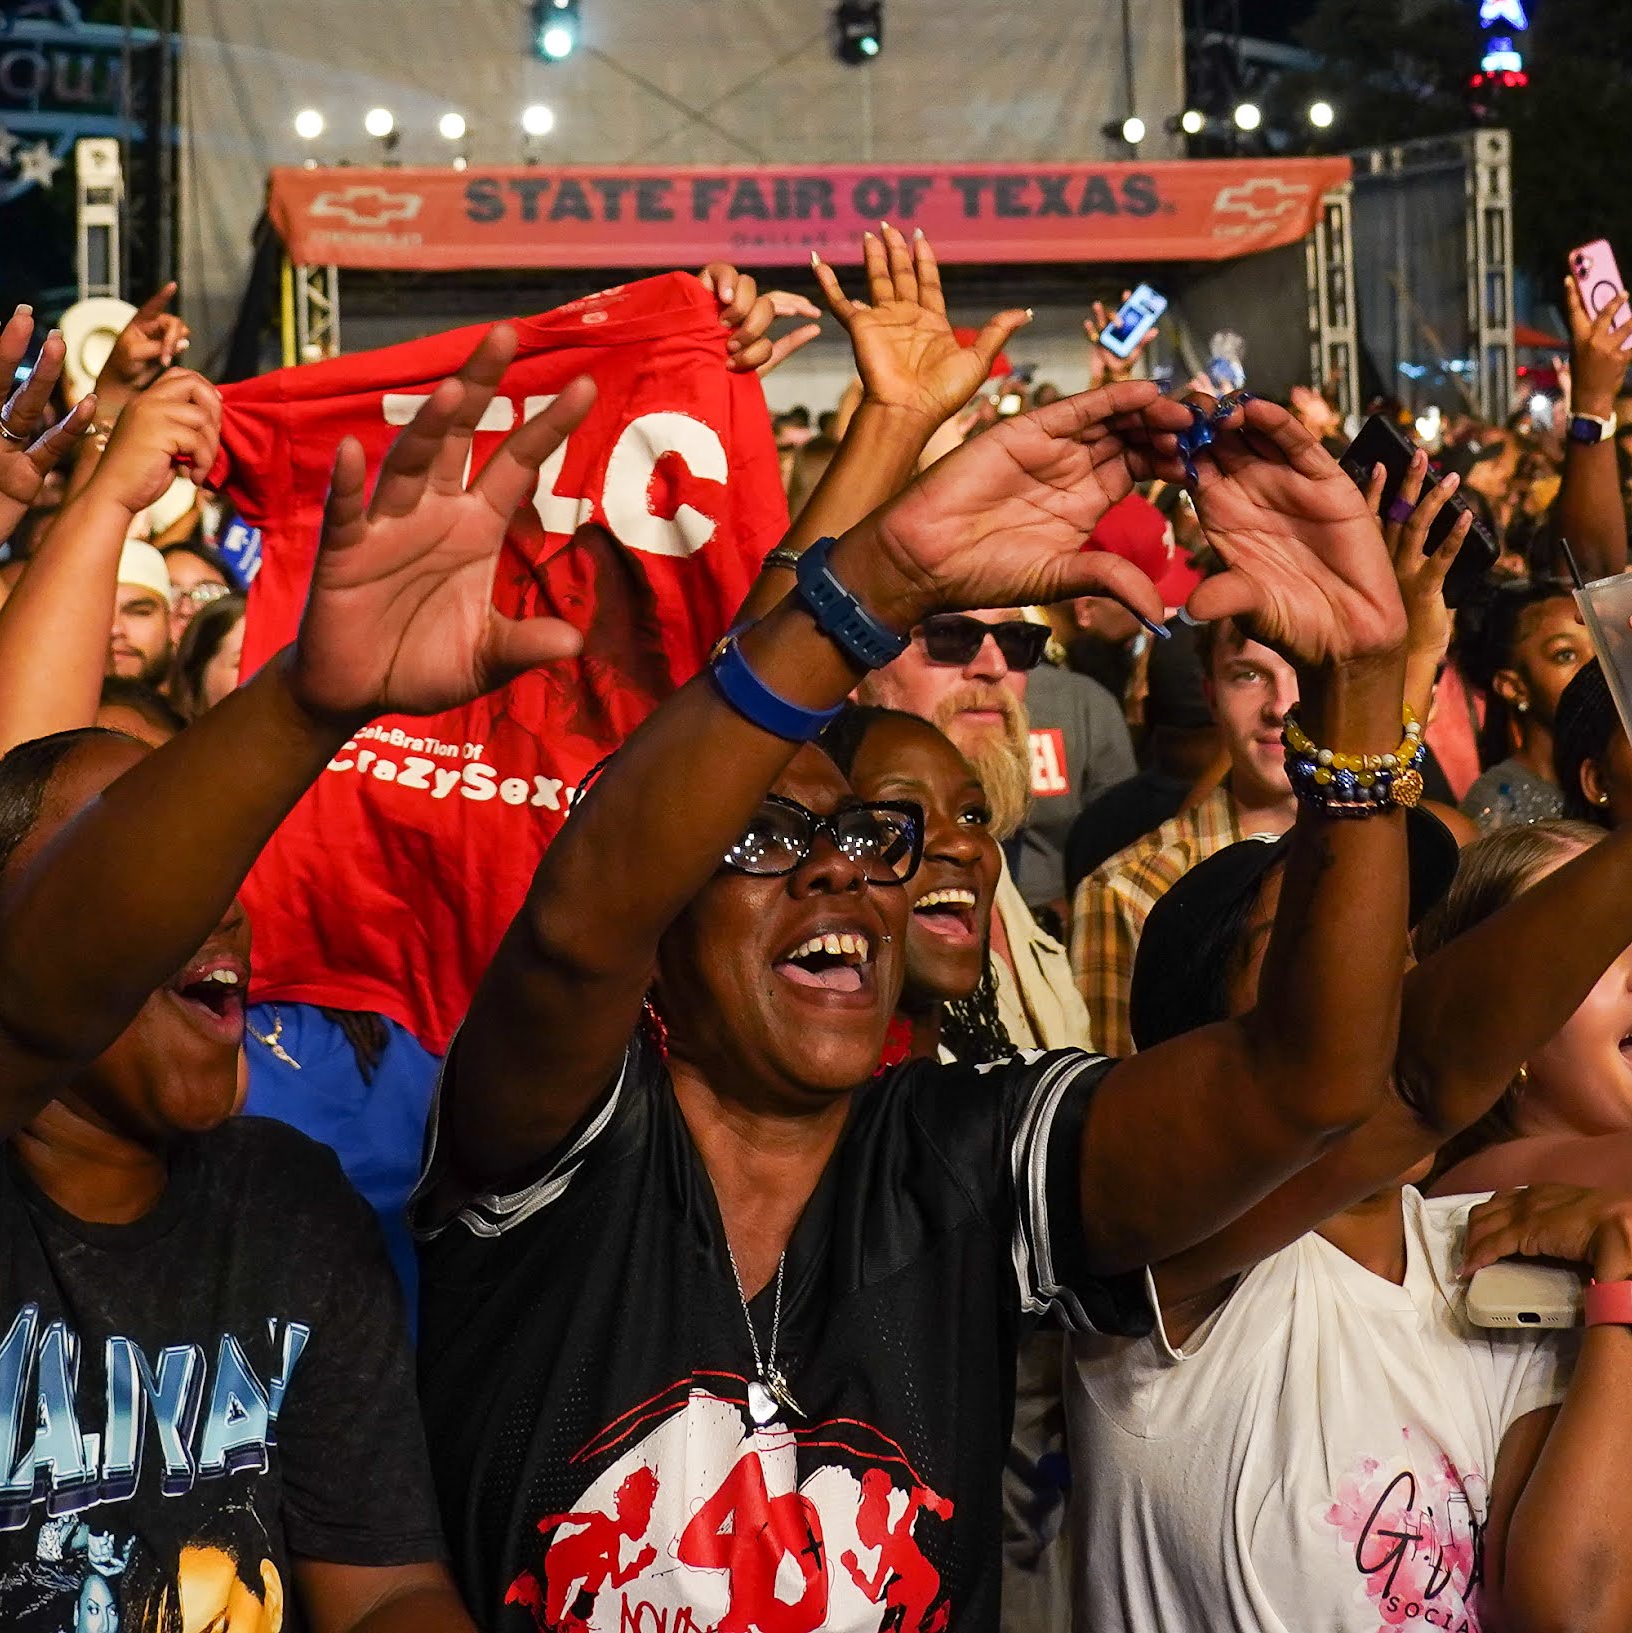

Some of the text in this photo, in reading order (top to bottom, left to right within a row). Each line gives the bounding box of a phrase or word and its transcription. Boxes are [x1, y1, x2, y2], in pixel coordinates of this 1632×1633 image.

[464, 176, 674, 223] STATE
[691, 176, 836, 221] FAIR
[854, 174, 932, 220] OF
